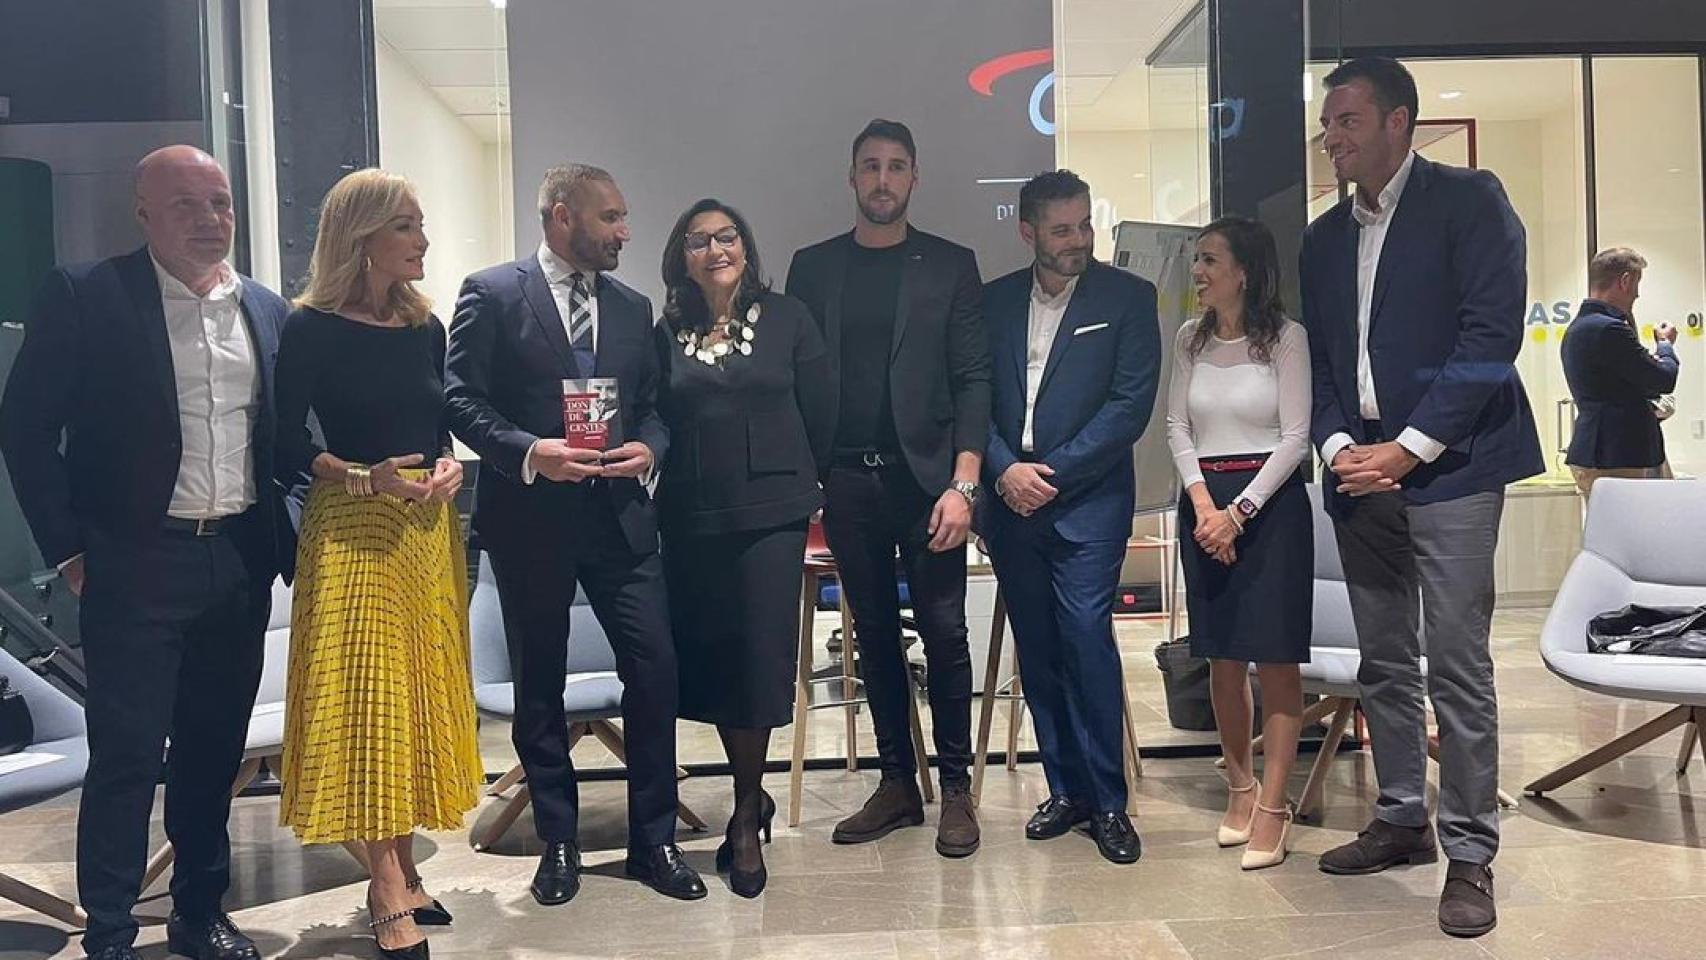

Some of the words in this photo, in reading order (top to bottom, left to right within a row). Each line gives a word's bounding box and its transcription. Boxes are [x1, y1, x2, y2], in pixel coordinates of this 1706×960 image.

[567, 400, 589, 410] DON
[568, 412, 584, 421] DE
[569, 422, 608, 432] GENTES
